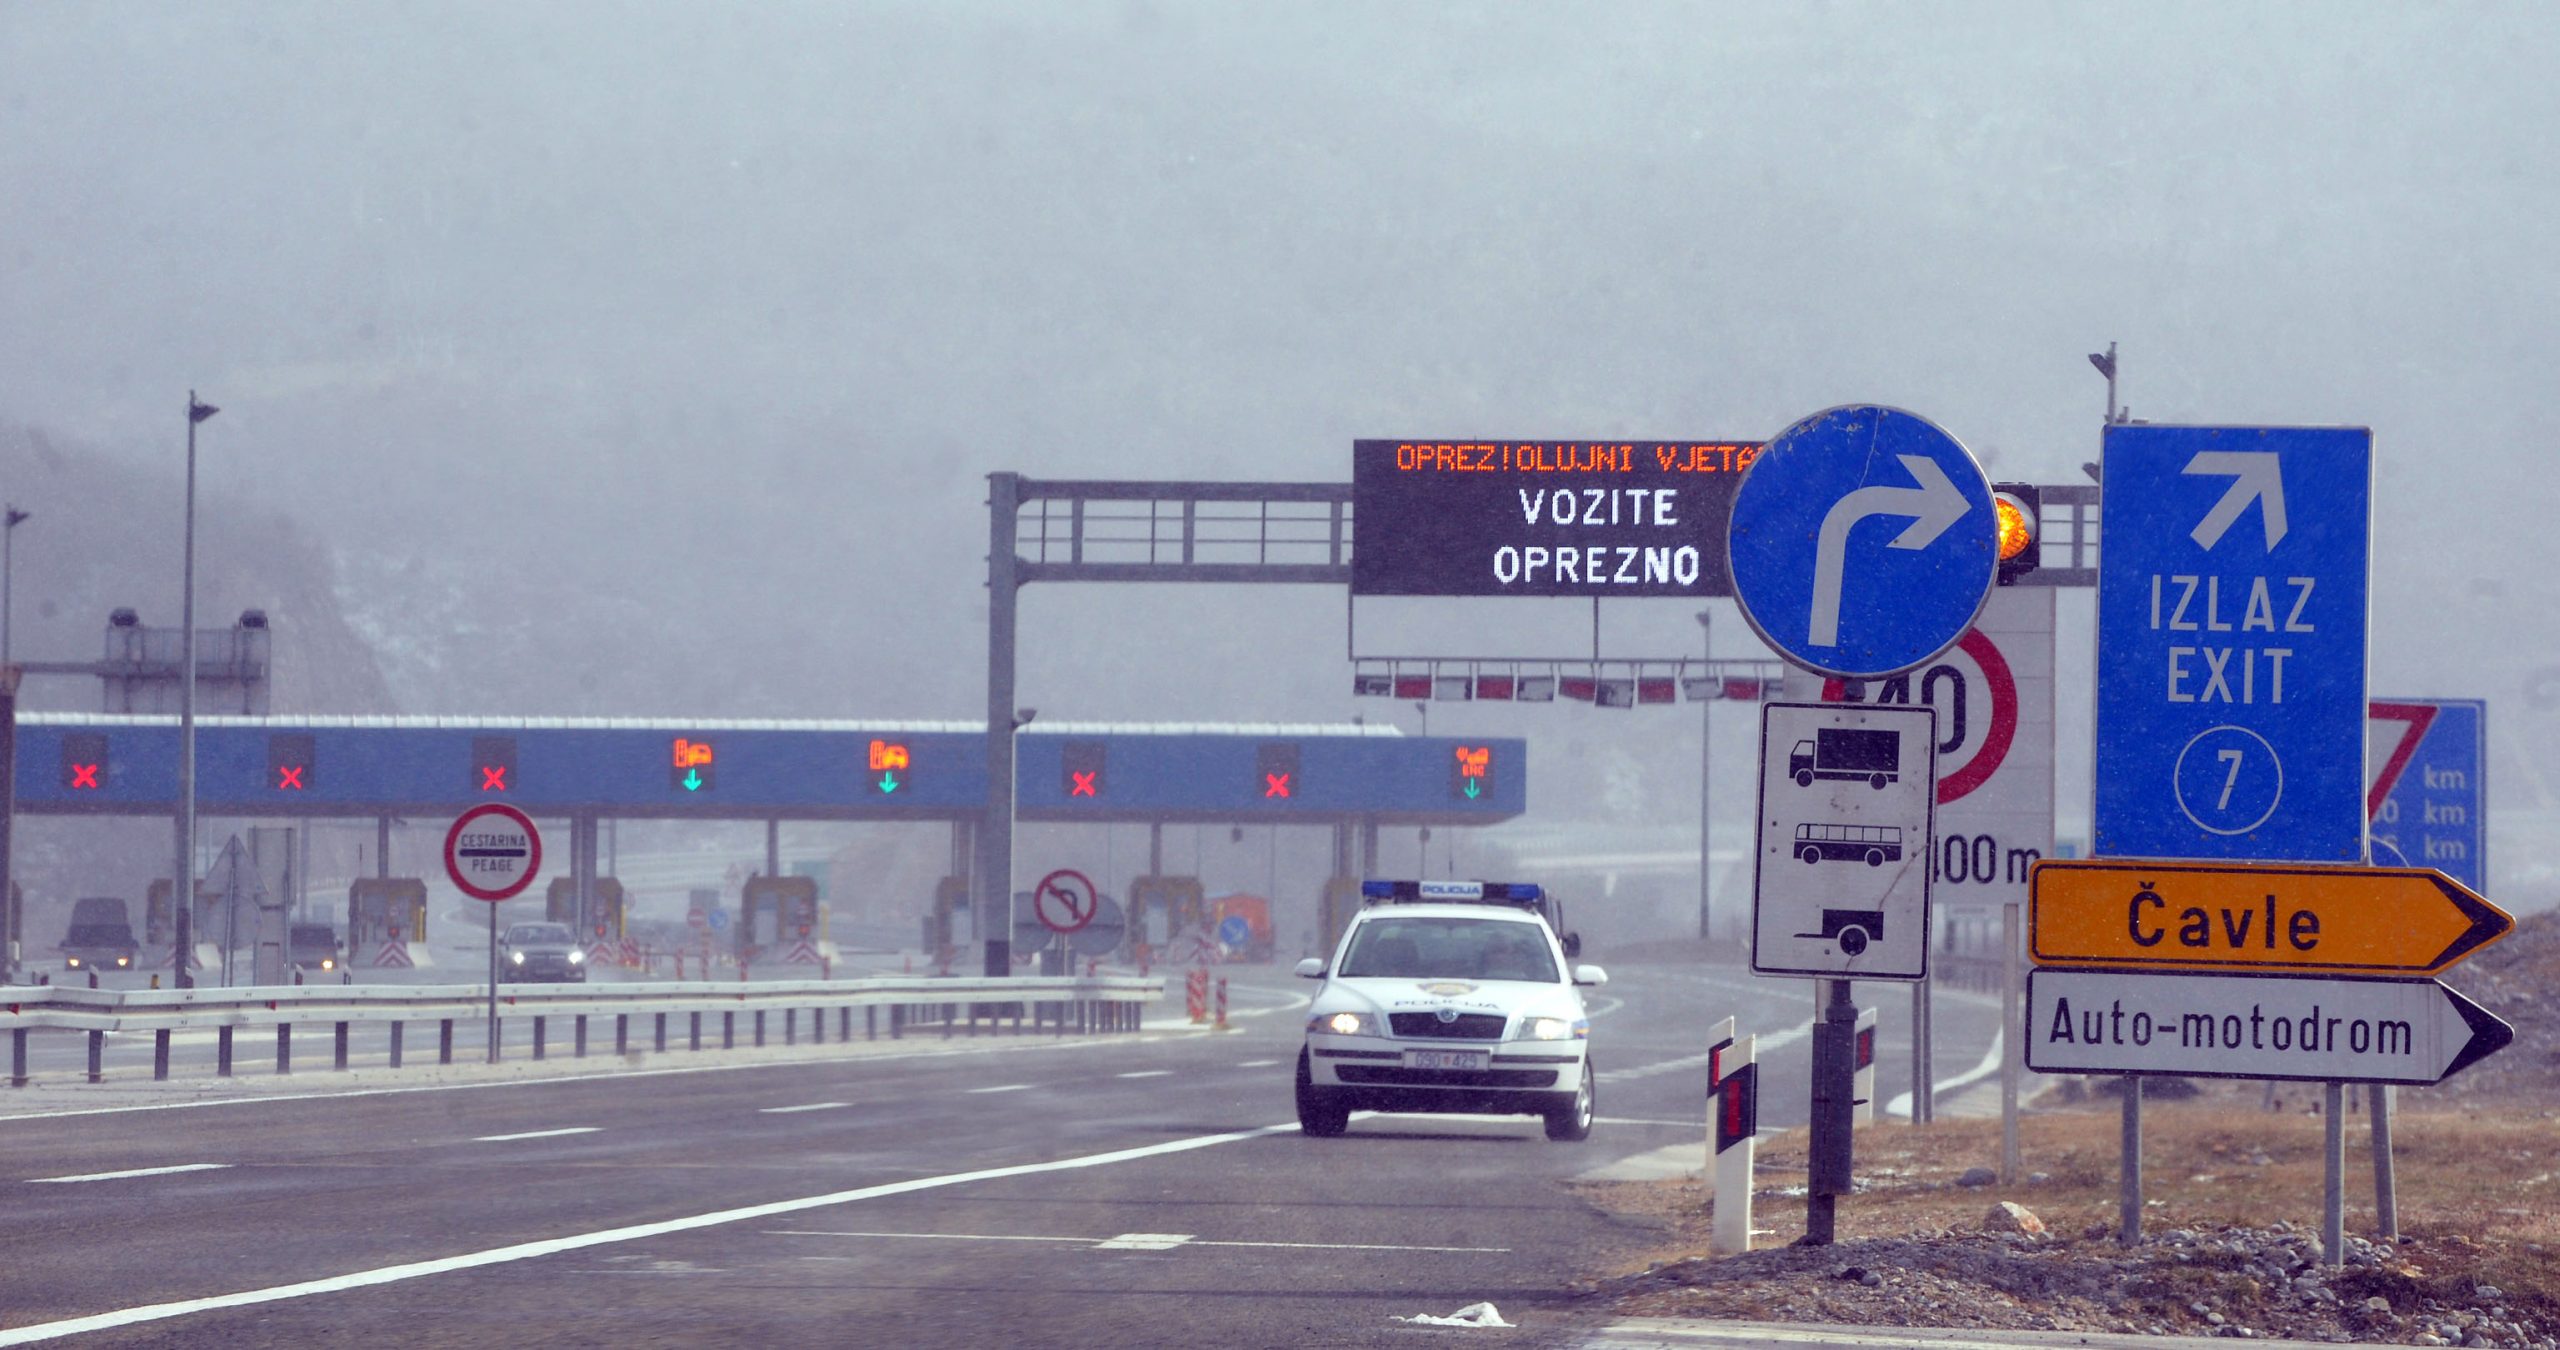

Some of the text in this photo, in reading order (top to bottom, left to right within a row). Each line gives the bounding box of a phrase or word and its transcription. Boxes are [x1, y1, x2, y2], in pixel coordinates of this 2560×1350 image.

[1656, 445, 1764, 473] VJETA
[1519, 488, 1678, 525] VOZITE
[1493, 545, 1700, 586] OPREZNO
[2151, 574, 2316, 633] IZLAZ
[2167, 646, 2294, 705] EXIT
[2217, 749, 2244, 811] 7
[2424, 763, 2466, 790] km
[2424, 797, 2466, 825] km
[461, 834, 527, 848] CESTARINA
[2424, 833, 2466, 860] km
[472, 858, 514, 872] PEAGE
[2006, 848, 2041, 884] m
[1422, 884, 1481, 896] POLICIJA
[2128, 881, 2321, 951] Čavle
[2049, 997, 2412, 1056] Auto-motodrom
